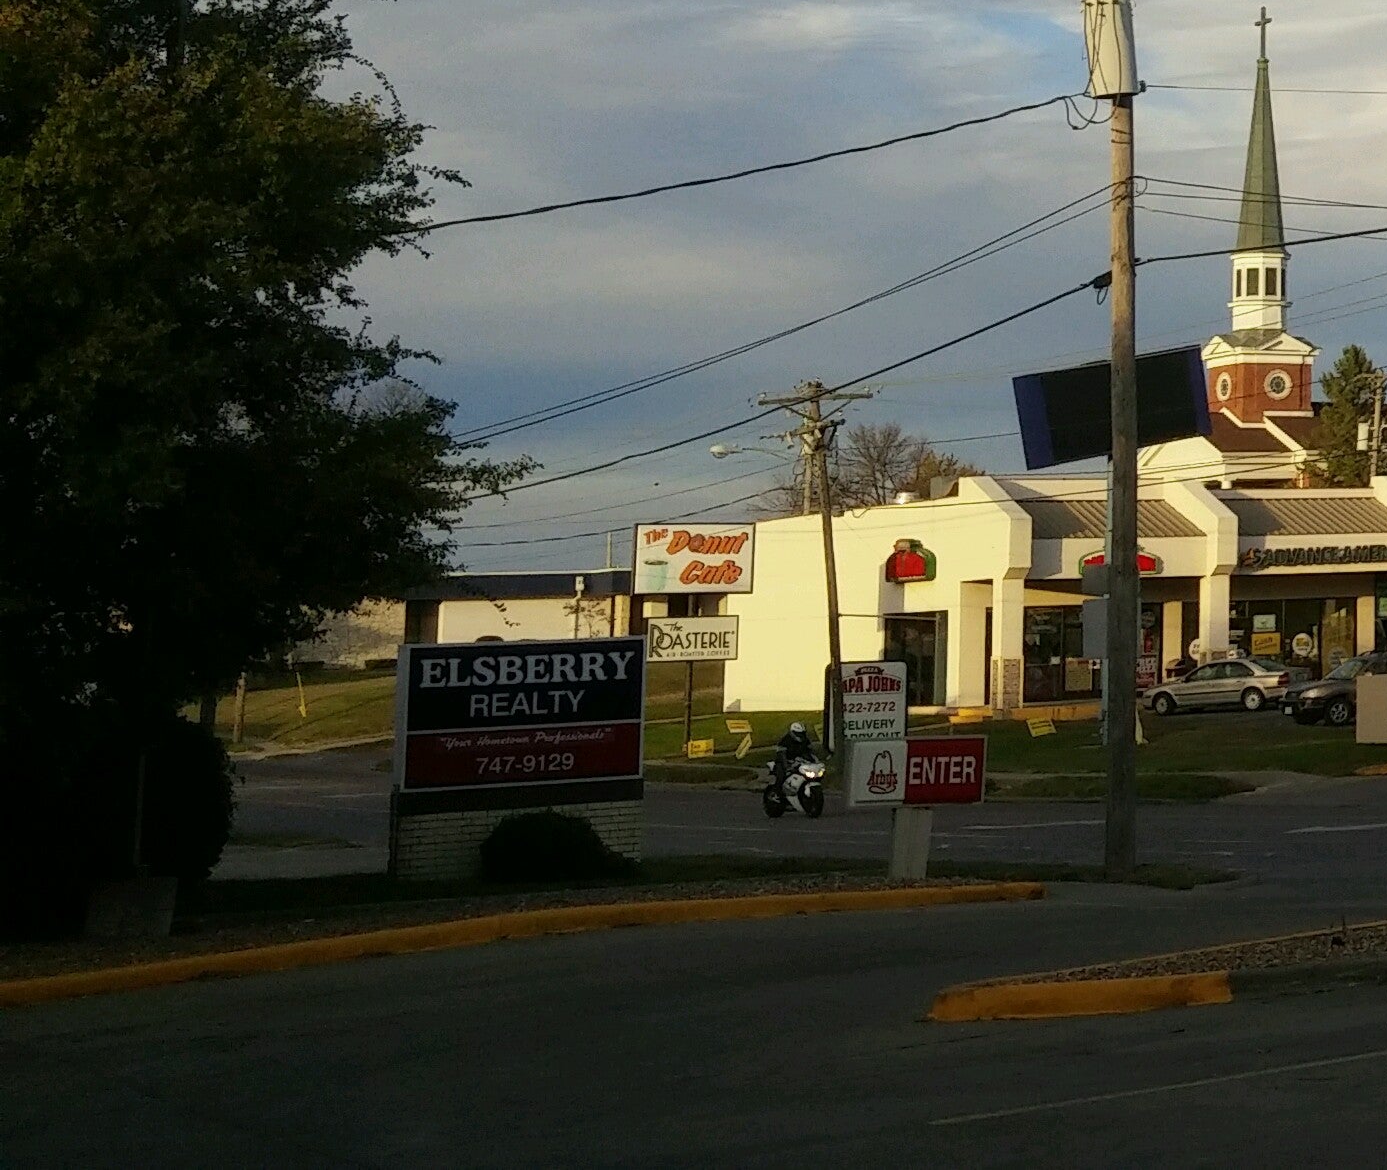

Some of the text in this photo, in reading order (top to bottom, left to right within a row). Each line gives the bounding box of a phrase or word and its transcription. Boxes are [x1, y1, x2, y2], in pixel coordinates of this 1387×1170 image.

[666, 530, 749, 555] Donut
[1263, 547, 1340, 566] ADVANCE
[664, 621, 683, 632] The
[649, 624, 732, 658] ROASTERIE
[419, 650, 635, 689] ELSBERRY
[469, 689, 586, 718] REALTY
[476, 753, 575, 775] 747-9129
[908, 755, 977, 785] ENTER
